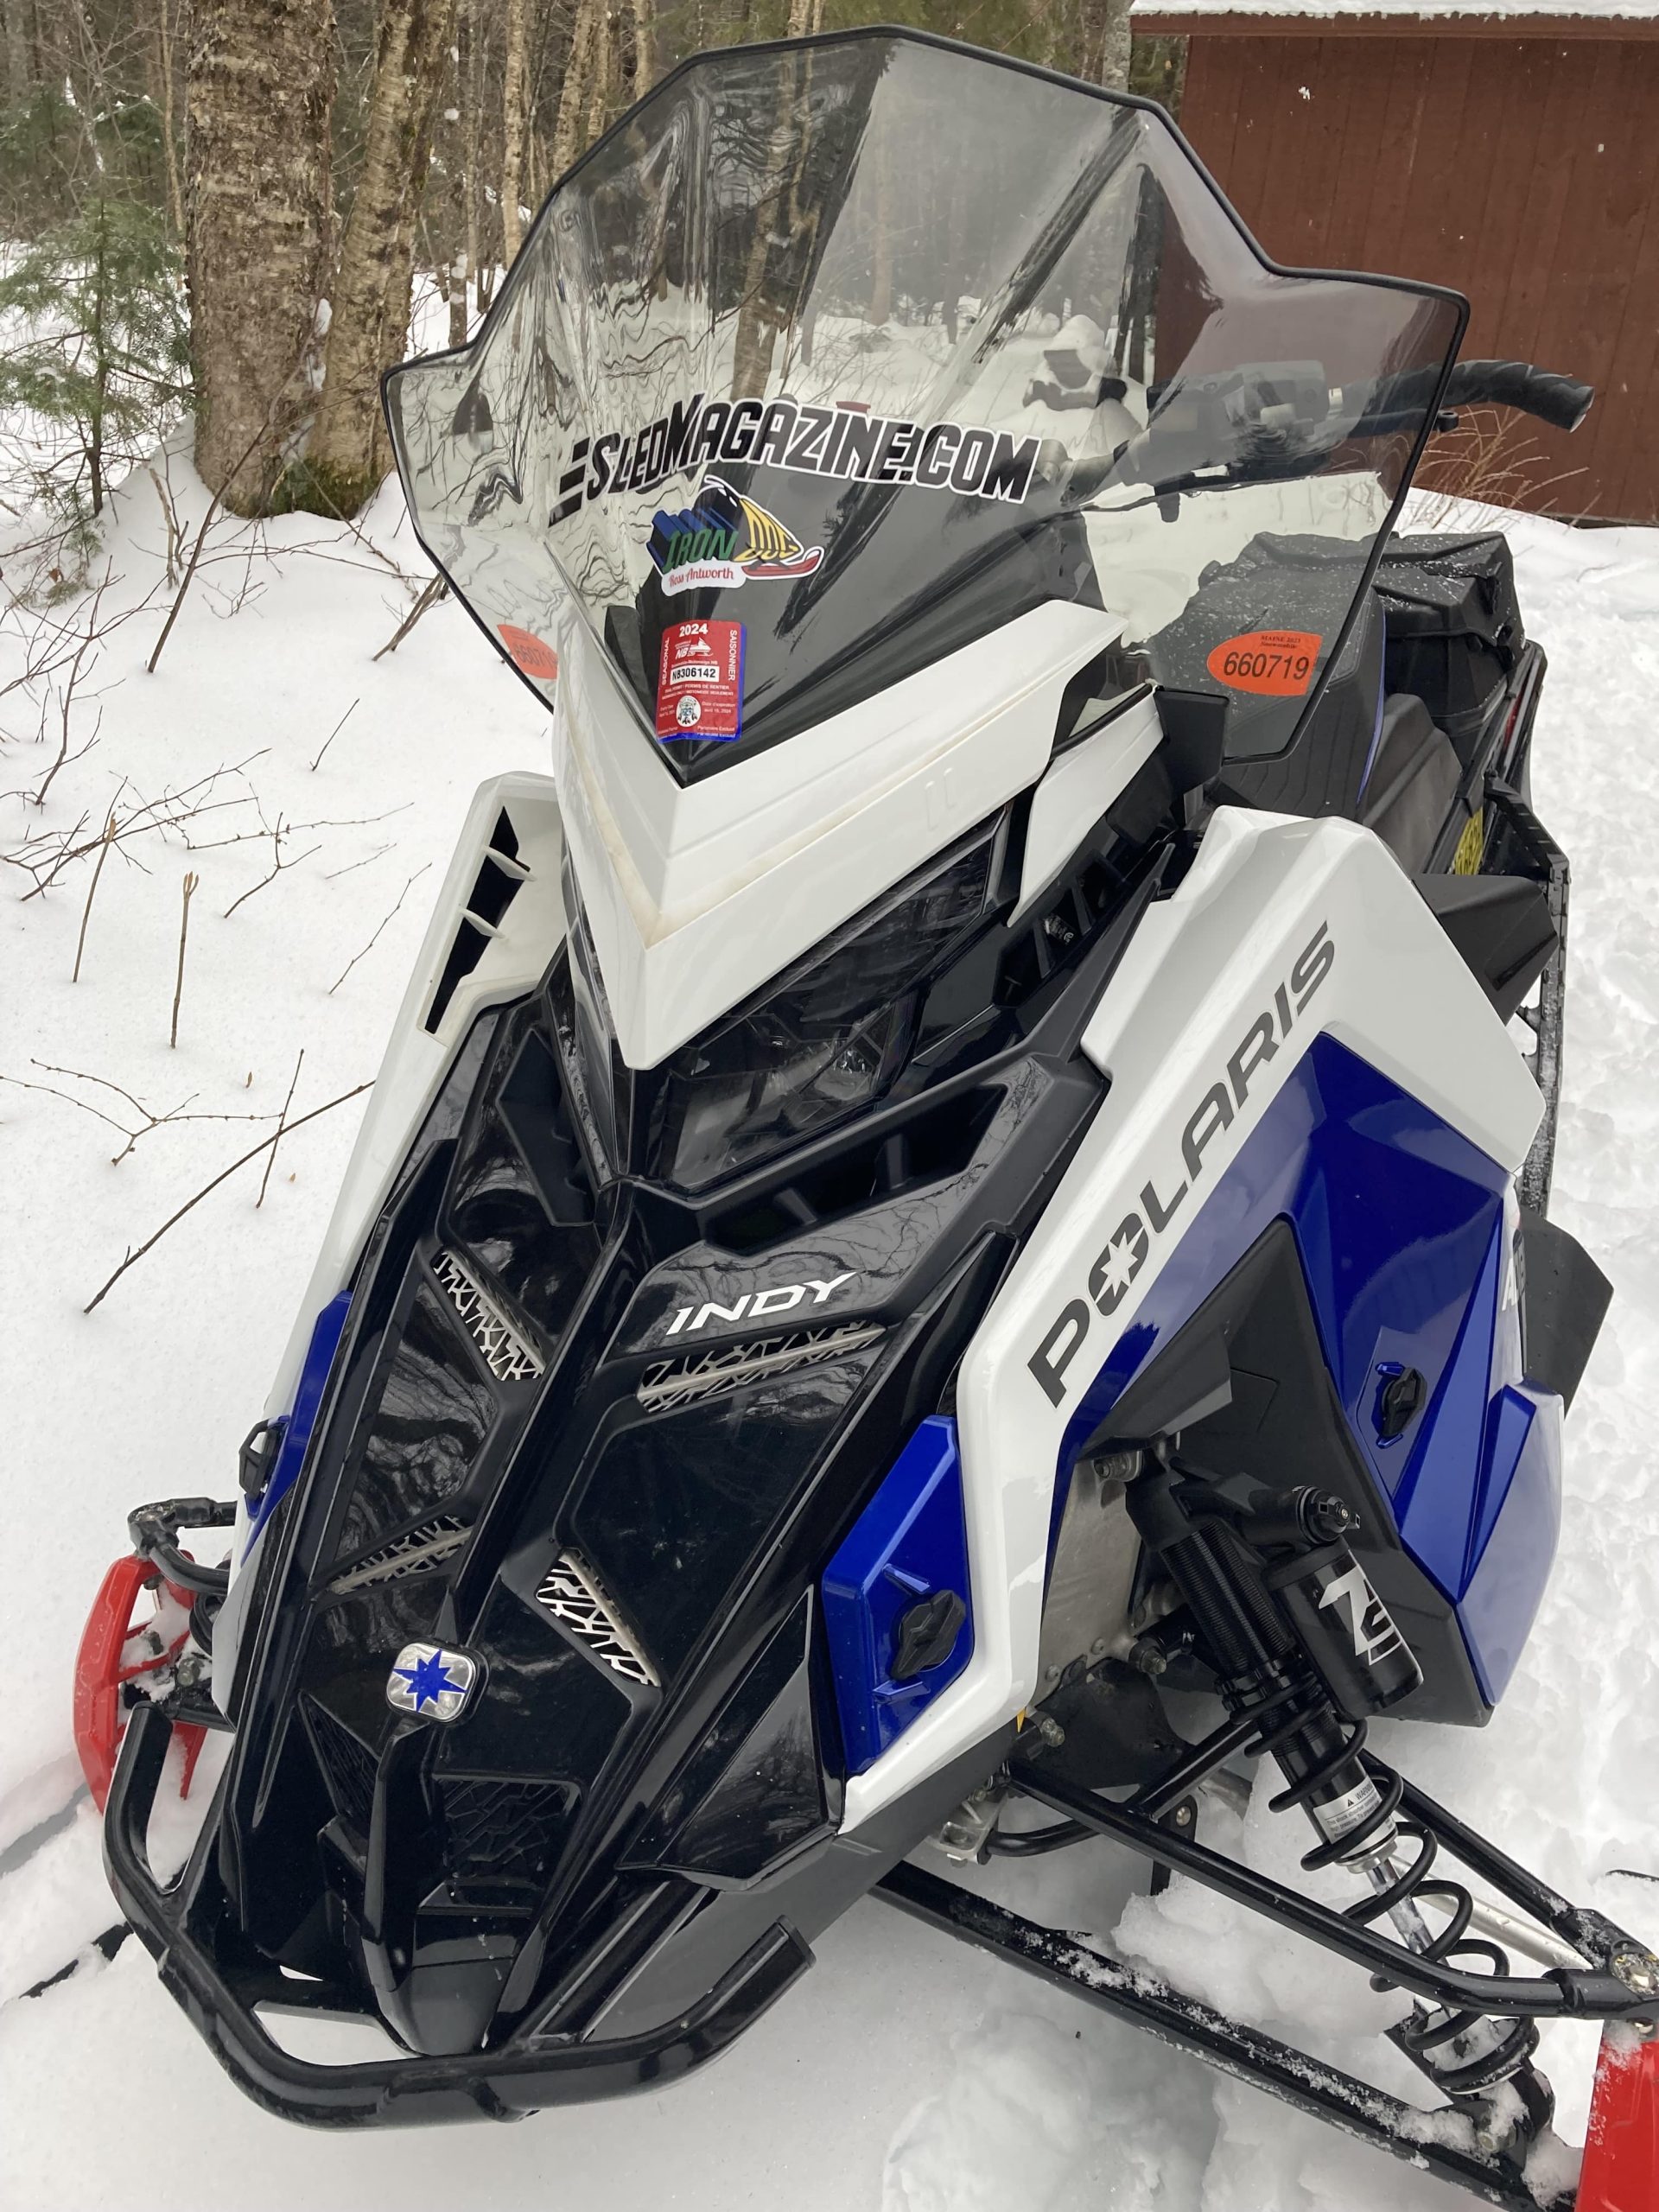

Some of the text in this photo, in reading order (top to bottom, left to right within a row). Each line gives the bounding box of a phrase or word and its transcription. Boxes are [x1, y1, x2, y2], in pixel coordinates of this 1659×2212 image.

[660, 497, 800, 575] IRON DOG
[668, 567, 734, 588] Ross Antworth
[678, 623, 709, 637] 2024
[675, 647, 690, 659] NB
[728, 629, 738, 682] SAISONNIER
[1223, 651, 1310, 681] 660719
[671, 667, 716, 680] NB306142
[1027, 919, 1336, 1409] POLARIS
[665, 1271, 858, 1336] INDY
